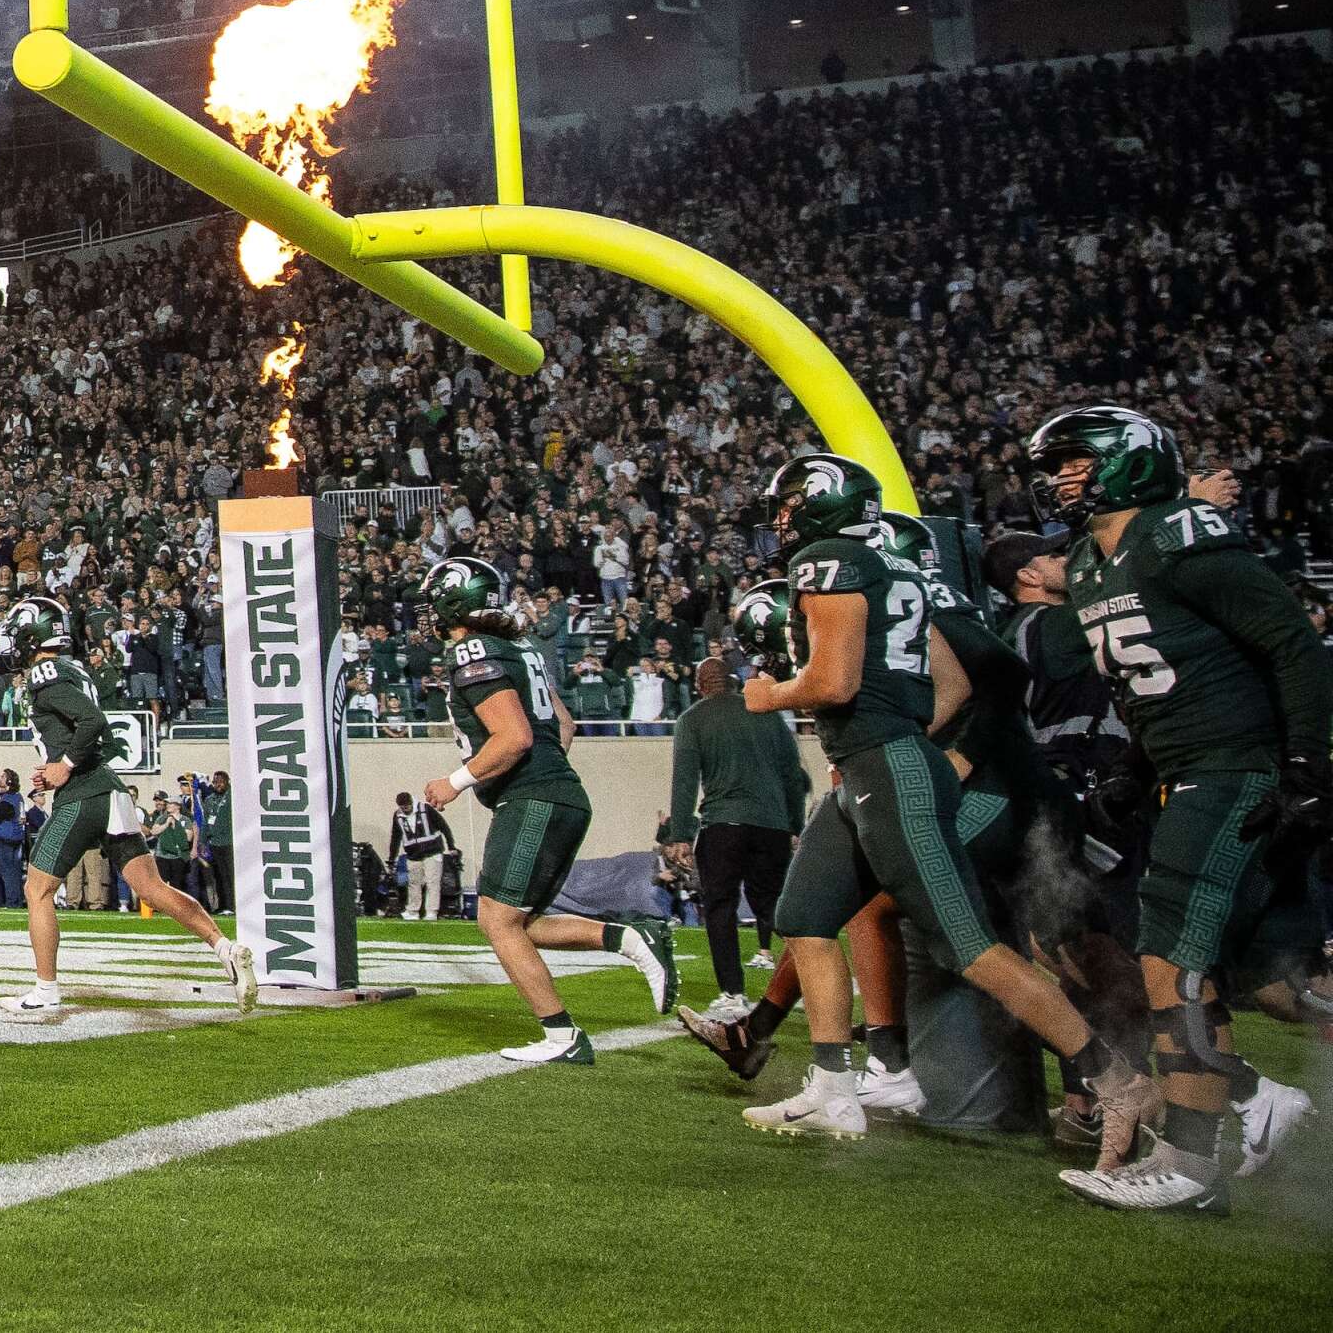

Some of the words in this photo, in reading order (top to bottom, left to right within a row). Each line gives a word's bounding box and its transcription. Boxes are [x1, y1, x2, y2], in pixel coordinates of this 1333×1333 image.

[1164, 505, 1229, 547] 75
[797, 559, 841, 591] 27
[242, 538, 301, 688] STATE
[31, 660, 59, 685] 48
[455, 638, 487, 667] 69
[1085, 615, 1176, 696] 75
[254, 703, 317, 980] MICHIGAN
